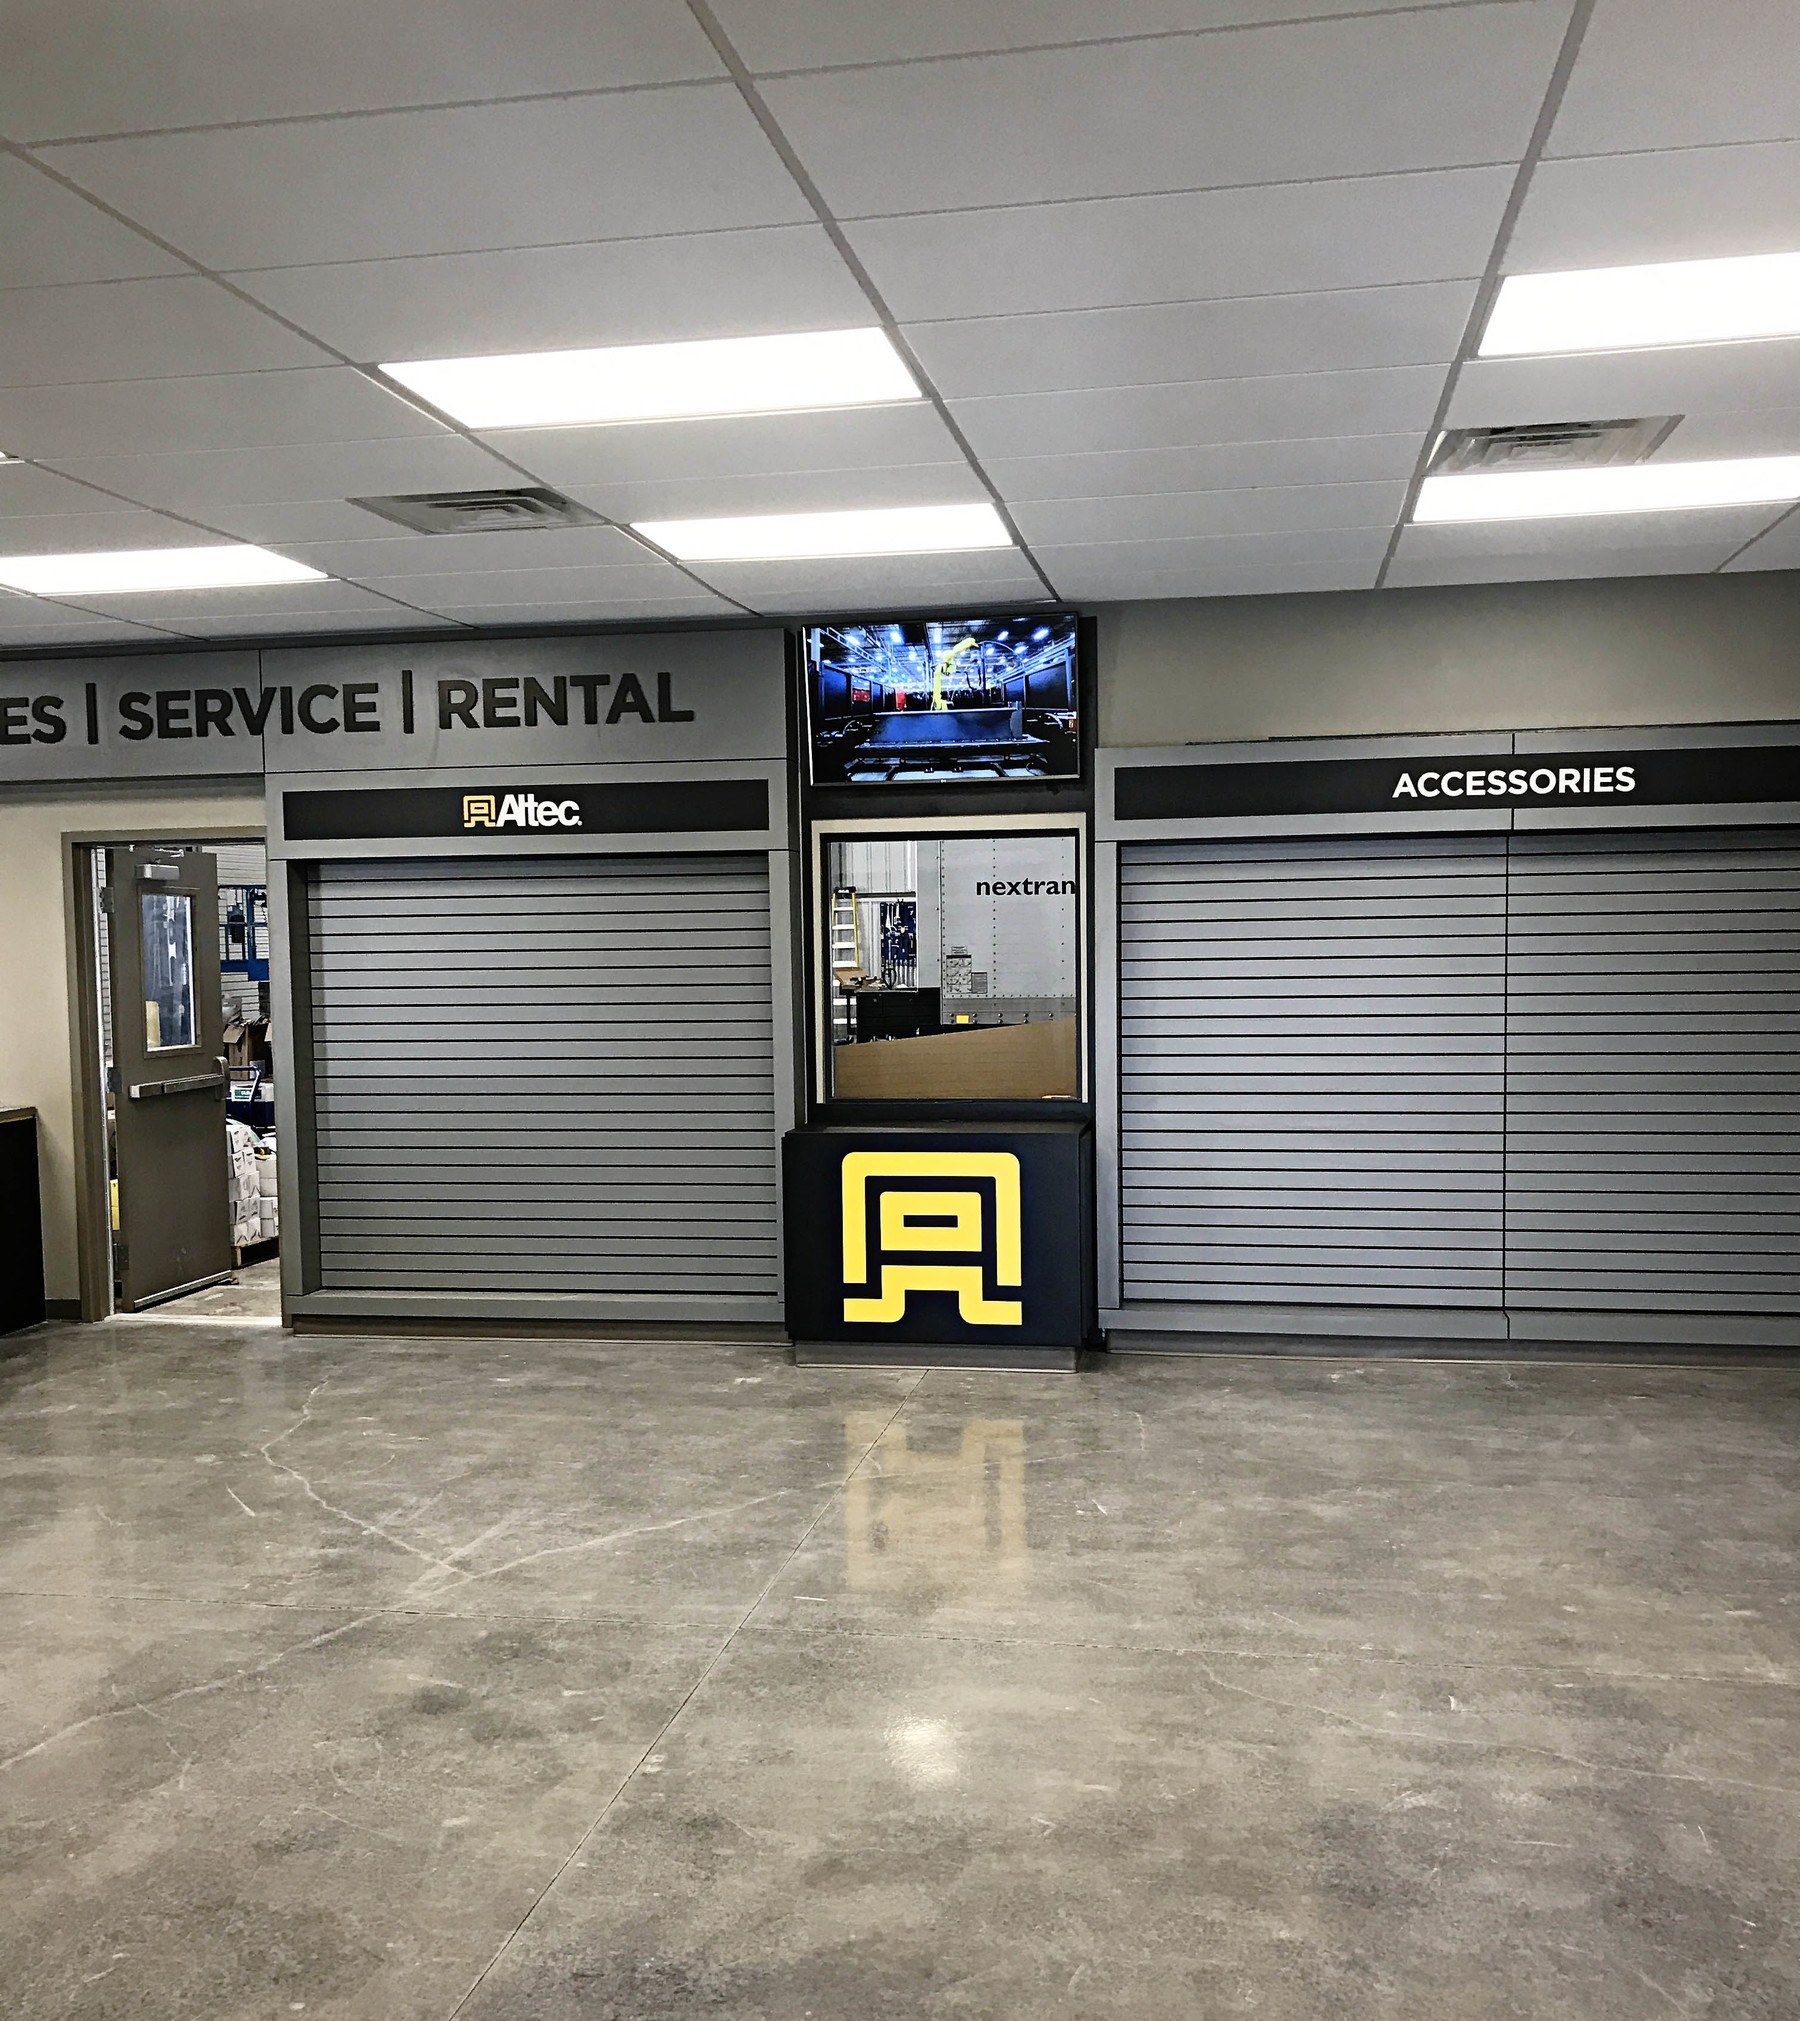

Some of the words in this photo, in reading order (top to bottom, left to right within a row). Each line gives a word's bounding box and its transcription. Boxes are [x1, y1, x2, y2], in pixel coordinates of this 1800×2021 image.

[118, 682, 381, 741] SERVICE
[437, 672, 695, 729] RENTAL
[1391, 765, 1637, 799] ACCESSORIES
